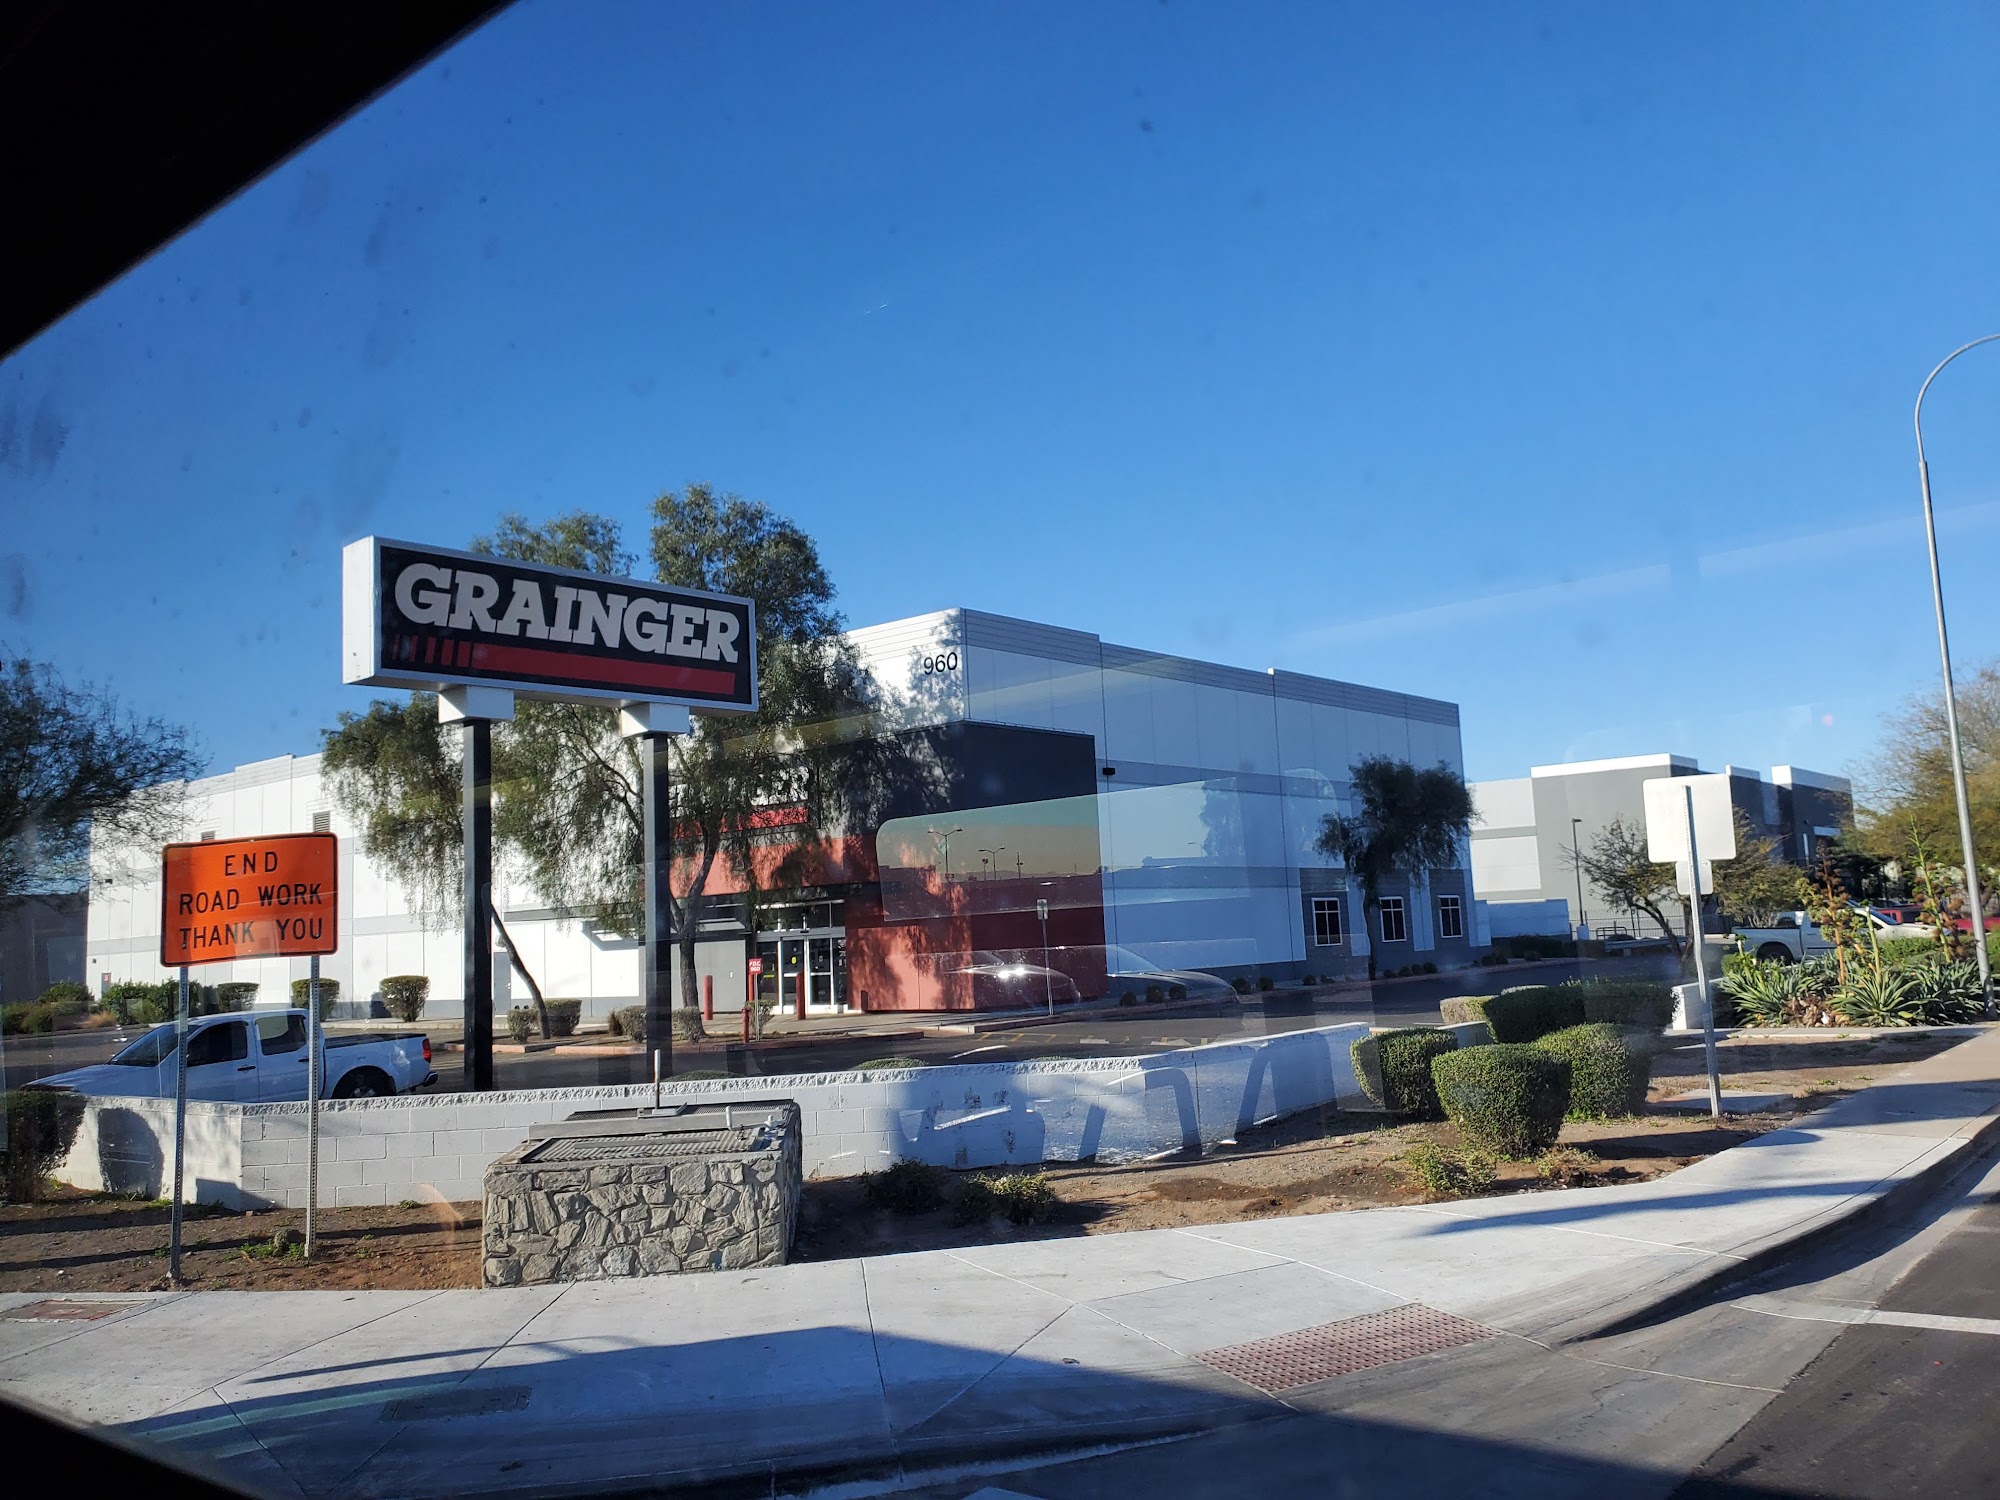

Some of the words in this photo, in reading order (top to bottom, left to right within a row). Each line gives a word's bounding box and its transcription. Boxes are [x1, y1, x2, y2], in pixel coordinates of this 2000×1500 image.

[395, 563, 740, 663] GRAINGER
[923, 651, 958, 675] 960
[225, 851, 278, 876] END
[179, 889, 240, 915] ROAD
[258, 883, 322, 907] WORK
[179, 921, 255, 950] THANK
[275, 918, 323, 941] YOU
